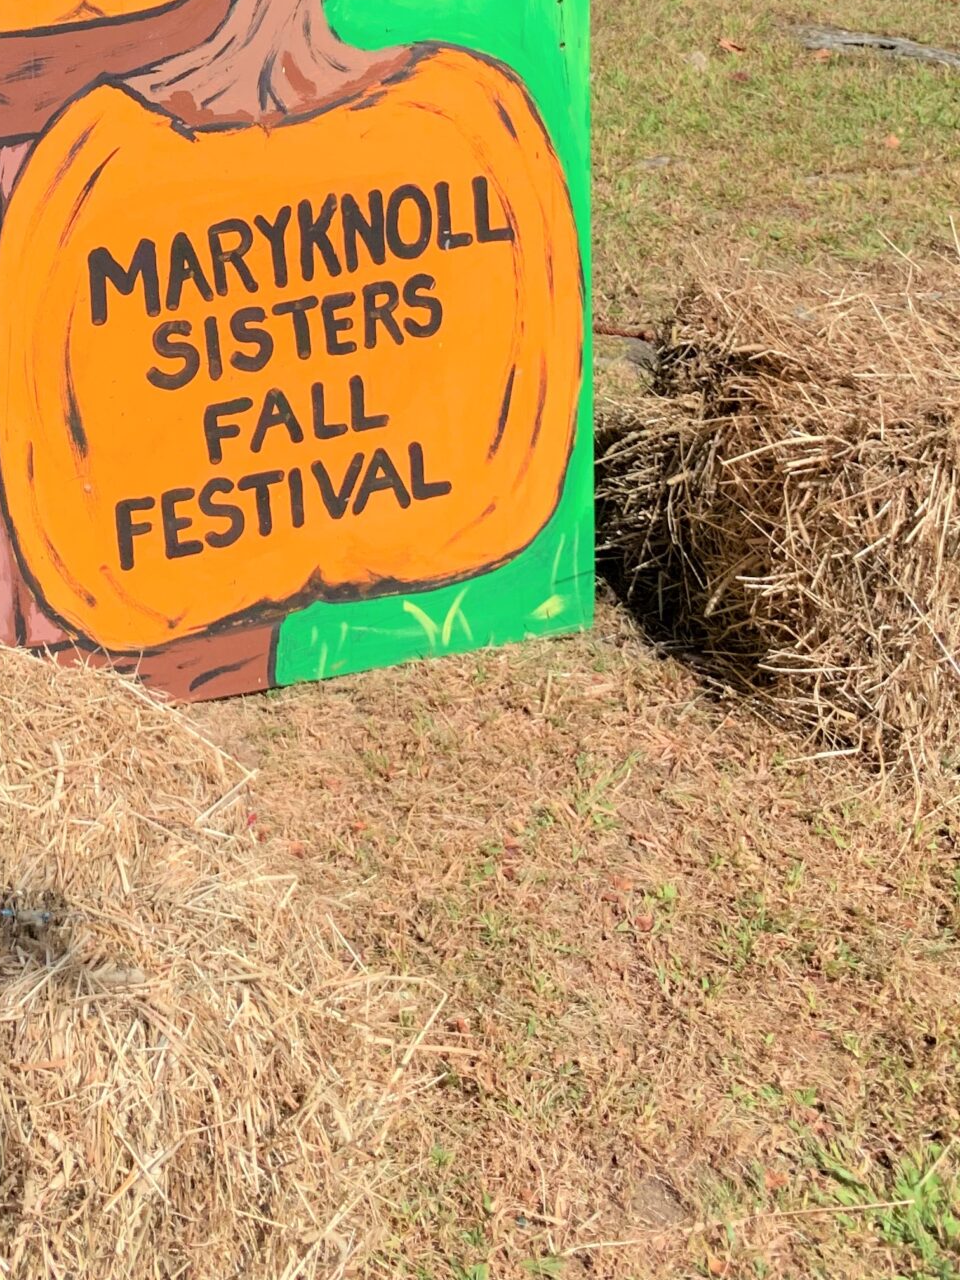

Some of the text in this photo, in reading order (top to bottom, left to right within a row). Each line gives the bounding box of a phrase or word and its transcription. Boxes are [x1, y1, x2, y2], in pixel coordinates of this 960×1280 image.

[87, 175, 514, 325] MARYKNOLL
[146, 273, 443, 391] SISTERS
[203, 374, 389, 464] FALL
[115, 441, 452, 571] FESTIVAL
